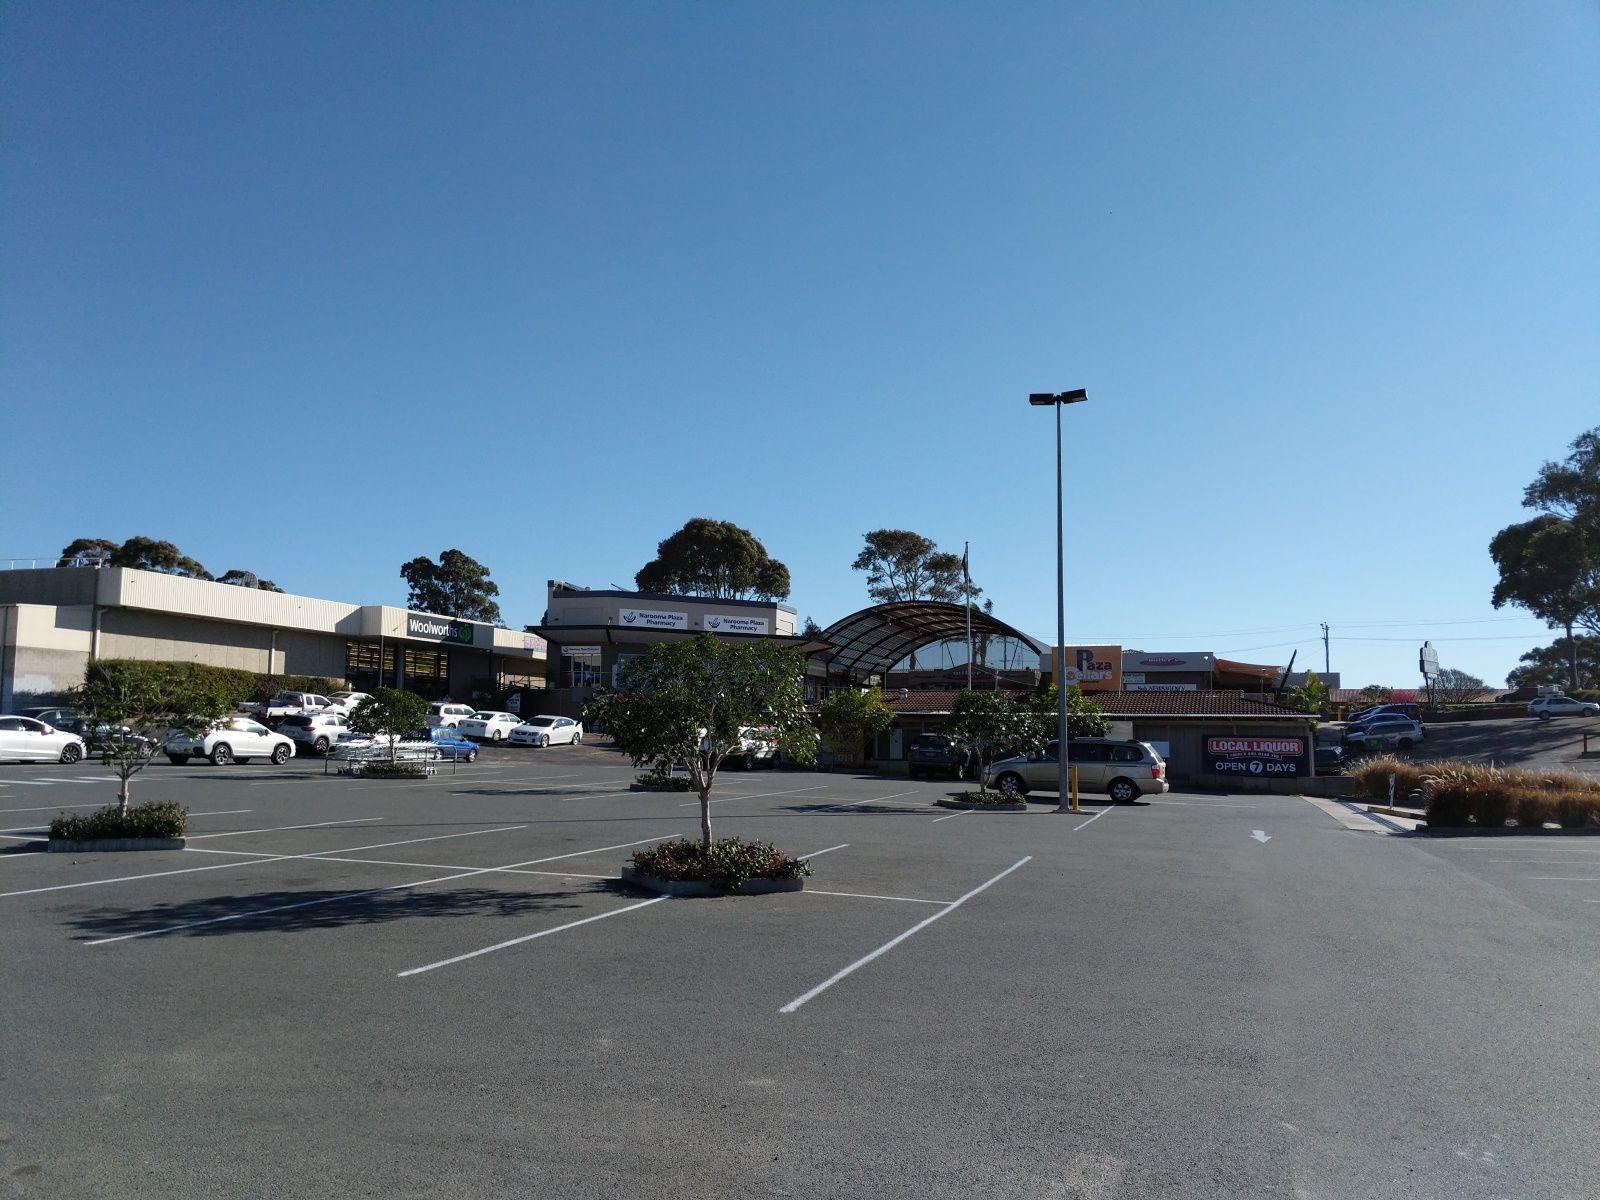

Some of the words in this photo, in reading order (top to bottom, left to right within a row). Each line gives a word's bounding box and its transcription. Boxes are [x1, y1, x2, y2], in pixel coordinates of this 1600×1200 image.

[409, 618, 458, 638] Woolworths
[646, 619, 676, 627] Pharmacy
[730, 624, 757, 632] Pharmacy
[1077, 649, 1113, 671] Plaza
[1212, 741, 1251, 752] LOCAL
[1253, 742, 1298, 753] LIQUOR
[1215, 762, 1246, 771] OPEN
[1266, 764, 1296, 772] DAYS
